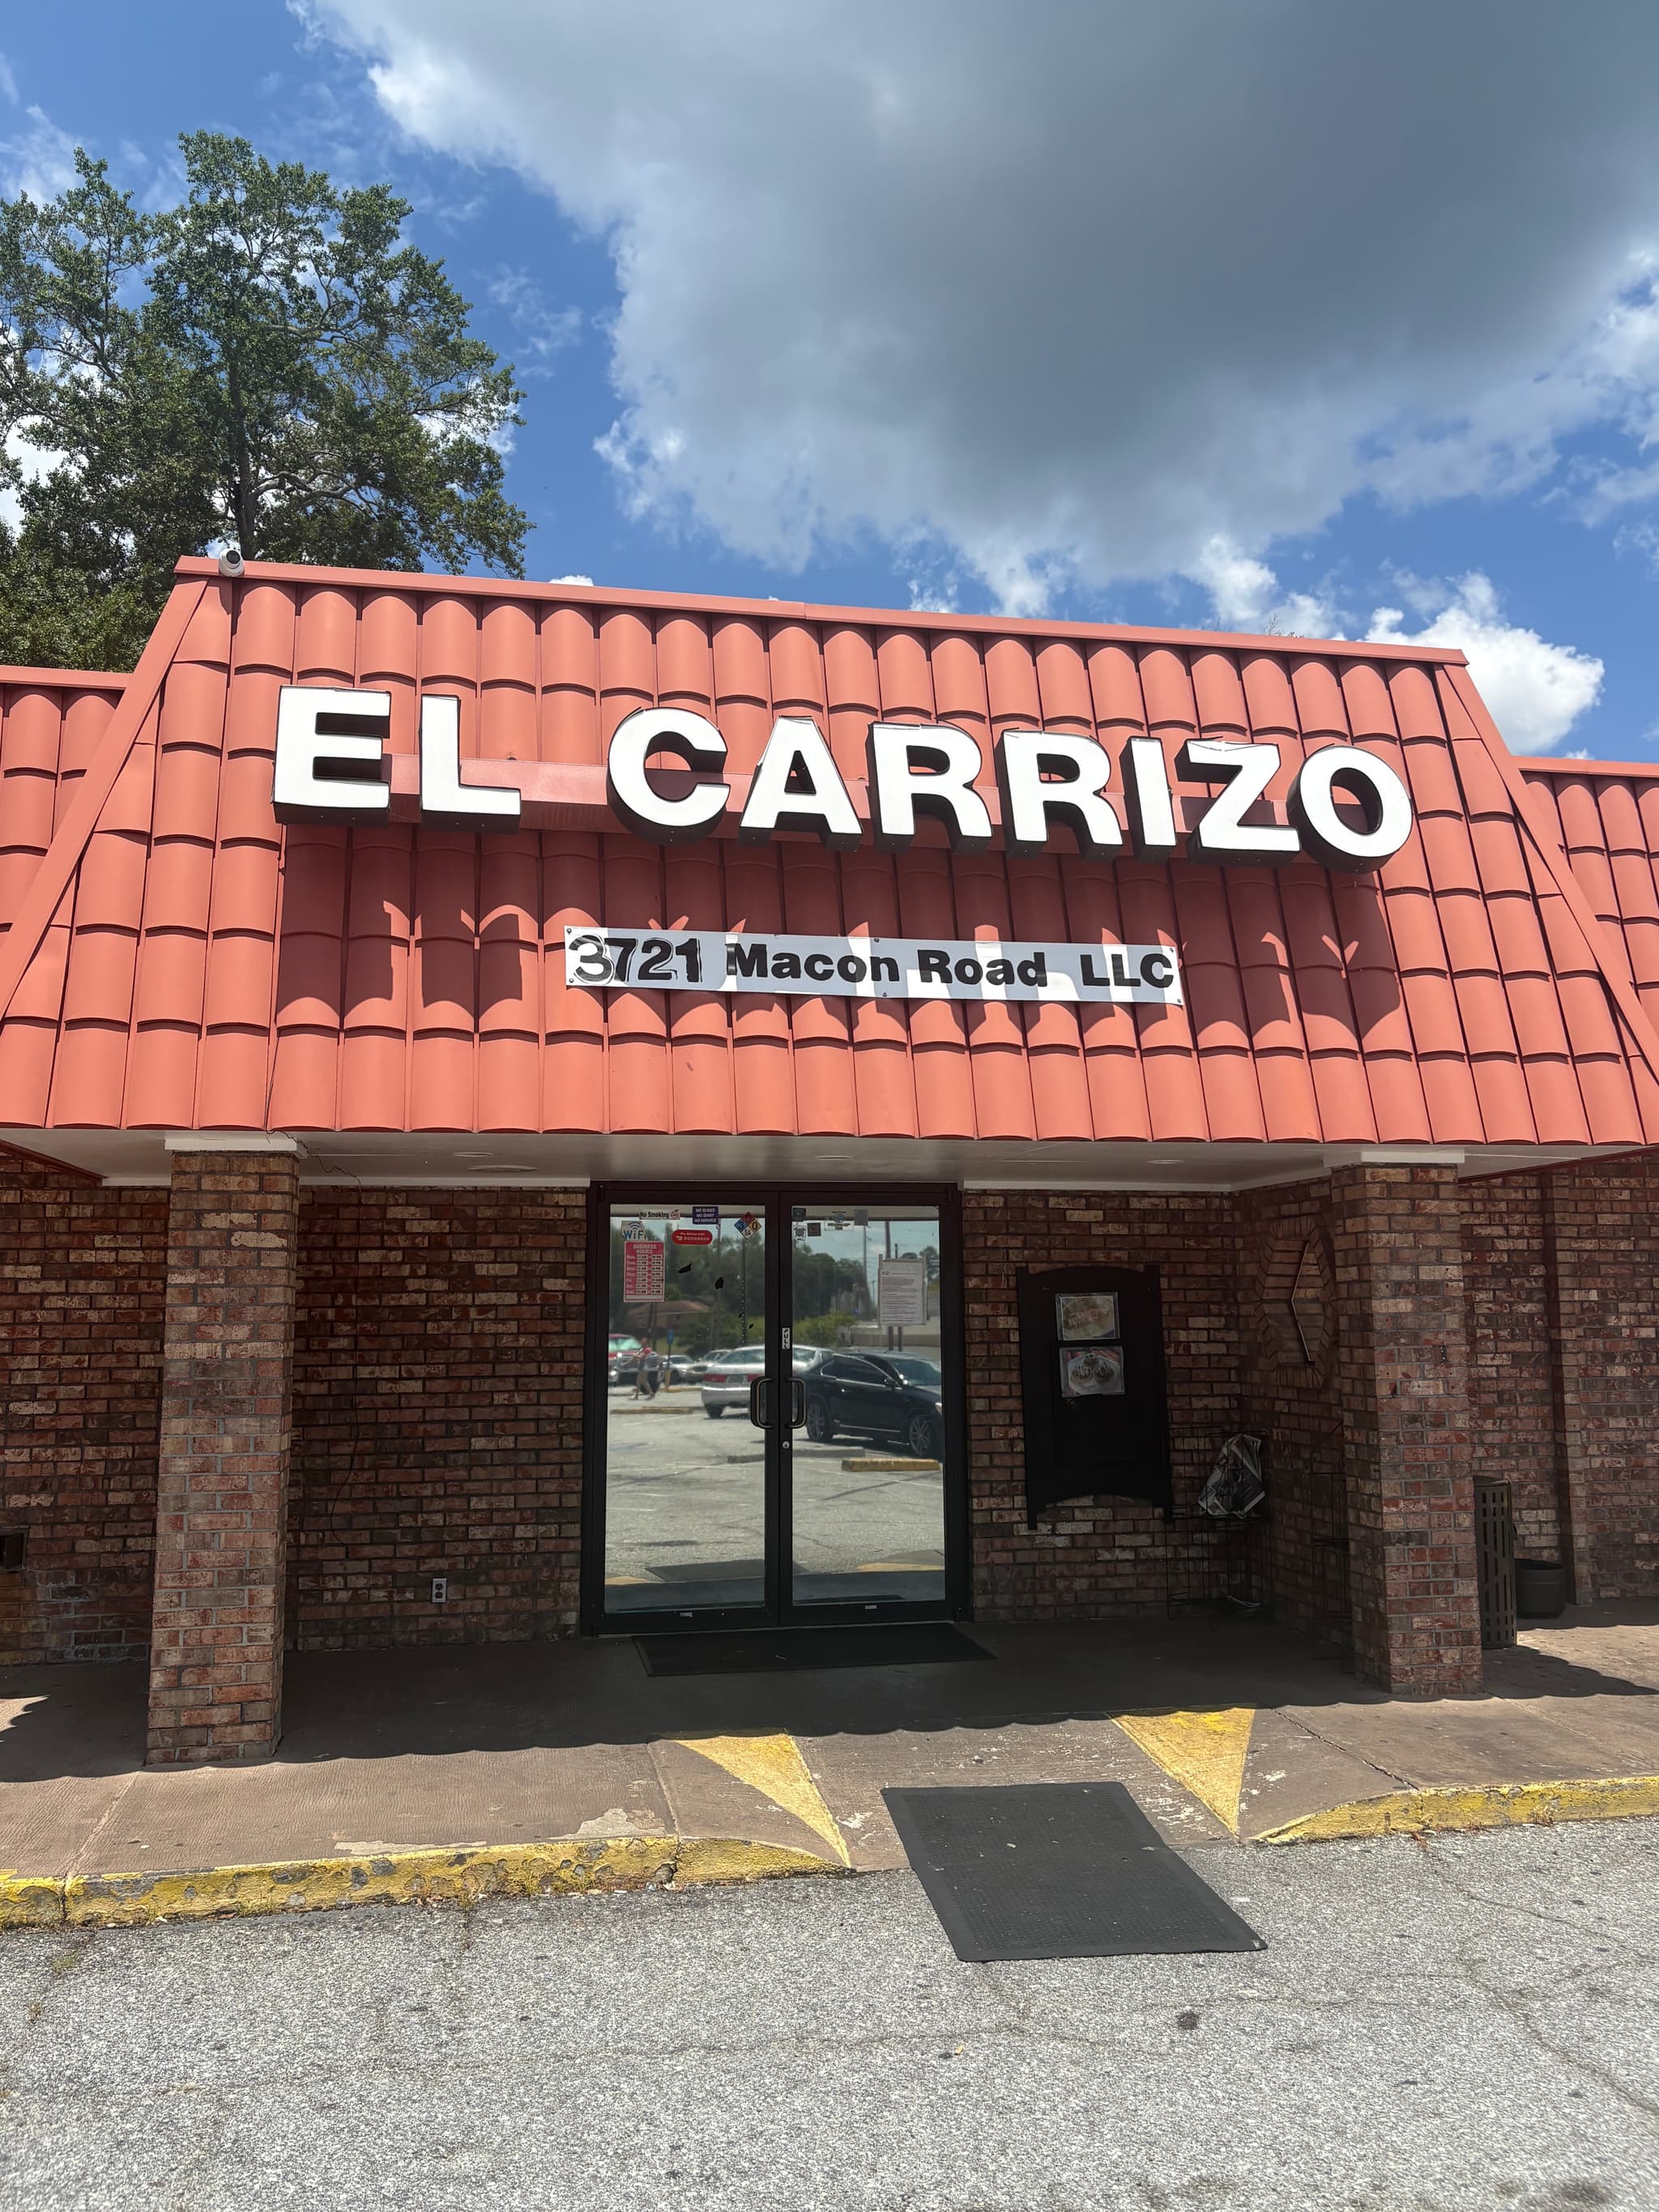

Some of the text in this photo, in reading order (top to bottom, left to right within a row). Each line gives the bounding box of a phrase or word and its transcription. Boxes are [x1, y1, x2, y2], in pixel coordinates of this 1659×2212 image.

[272, 684, 1412, 863] EL CARRIZO
[567, 933, 1175, 988] 3721 Macon Road LLC
[647, 1211, 669, 1219] Smoking
